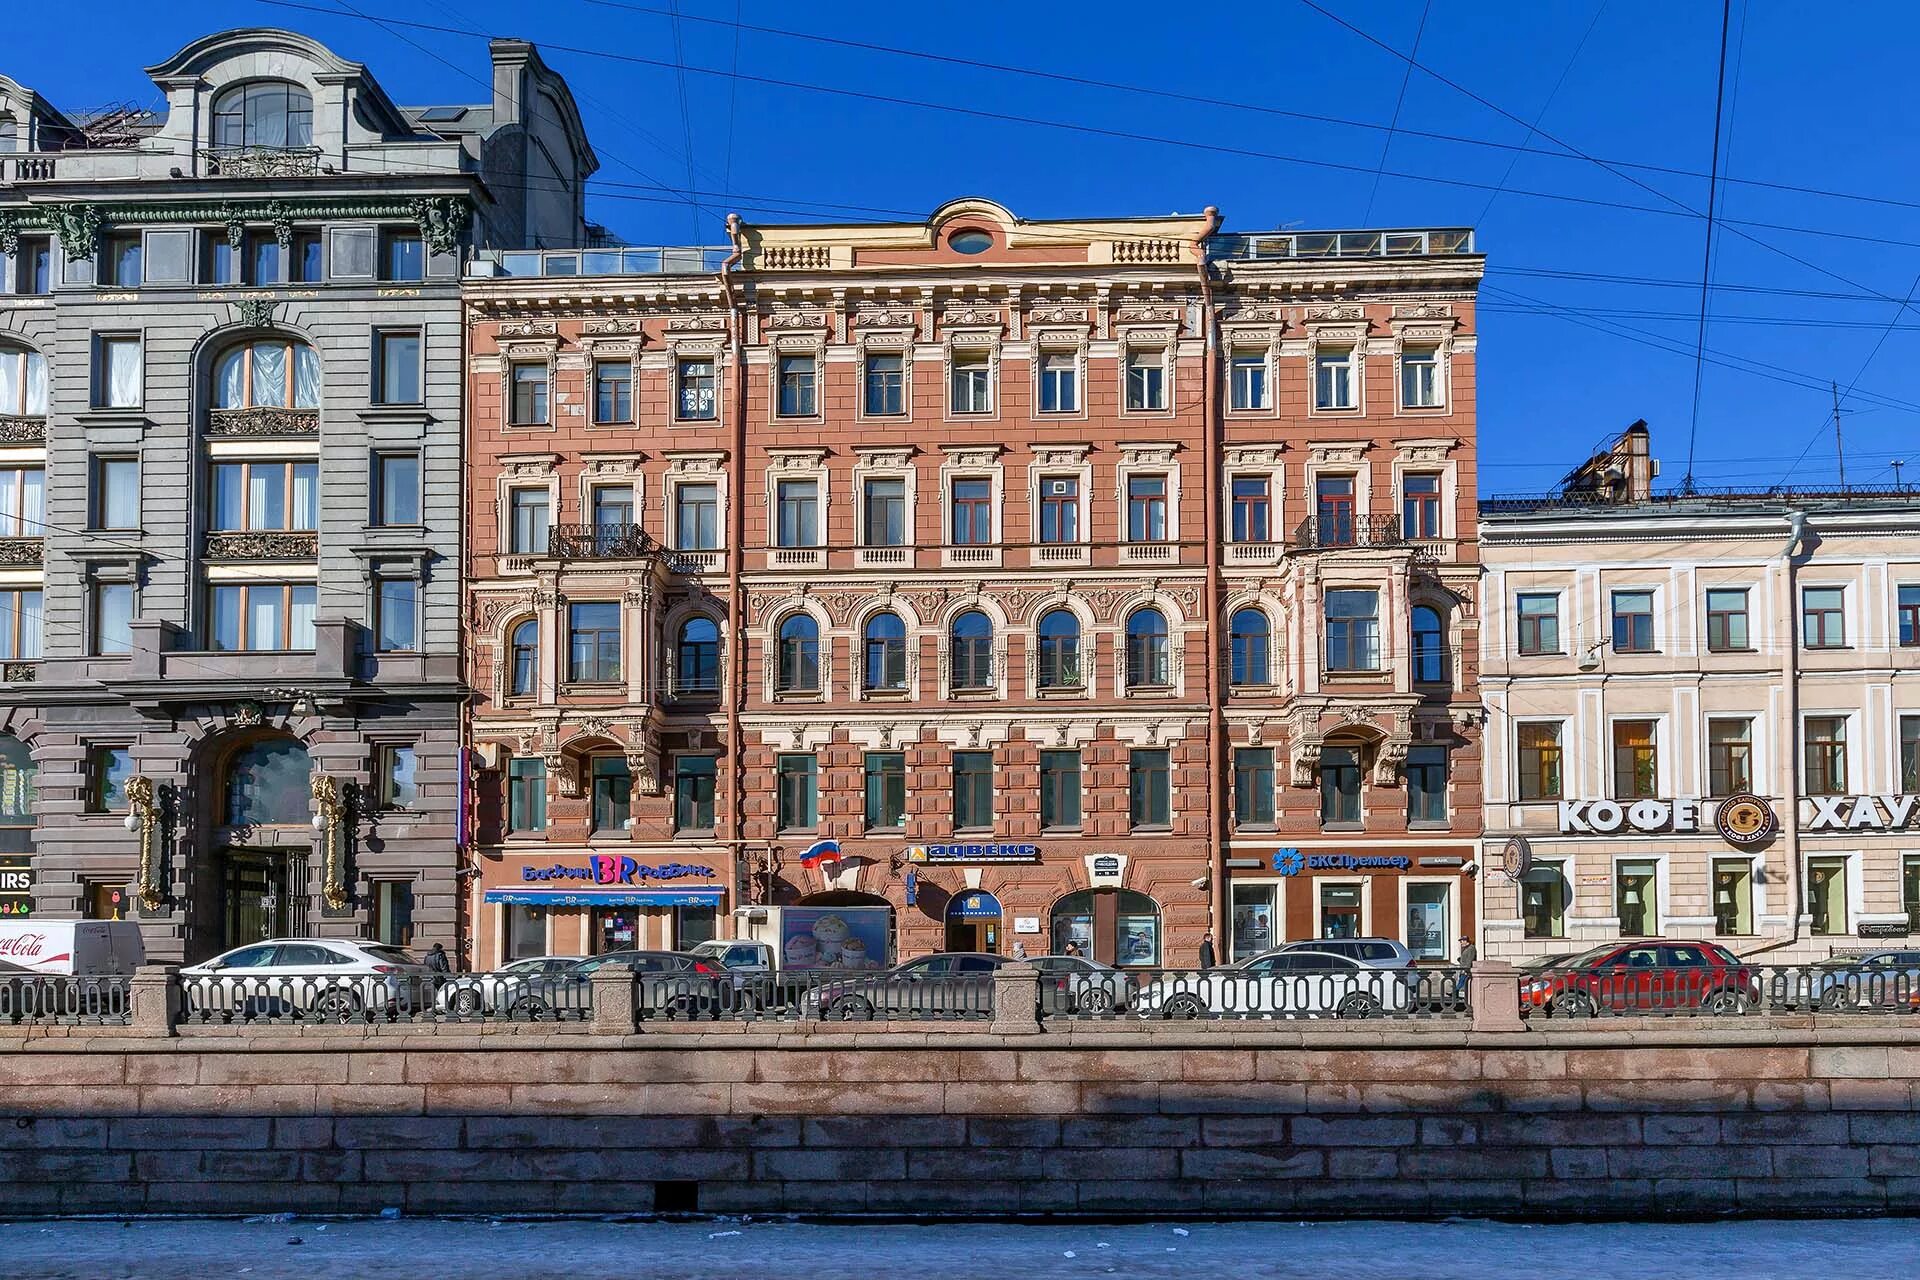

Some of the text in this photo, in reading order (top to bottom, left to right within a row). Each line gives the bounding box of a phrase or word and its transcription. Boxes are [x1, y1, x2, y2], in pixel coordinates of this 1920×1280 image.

[1558, 796, 1916, 832] КОФЕ ХАУ
[1727, 829, 1764, 841] КОФЕ ХАУЗ
[589, 856, 637, 884] BR
